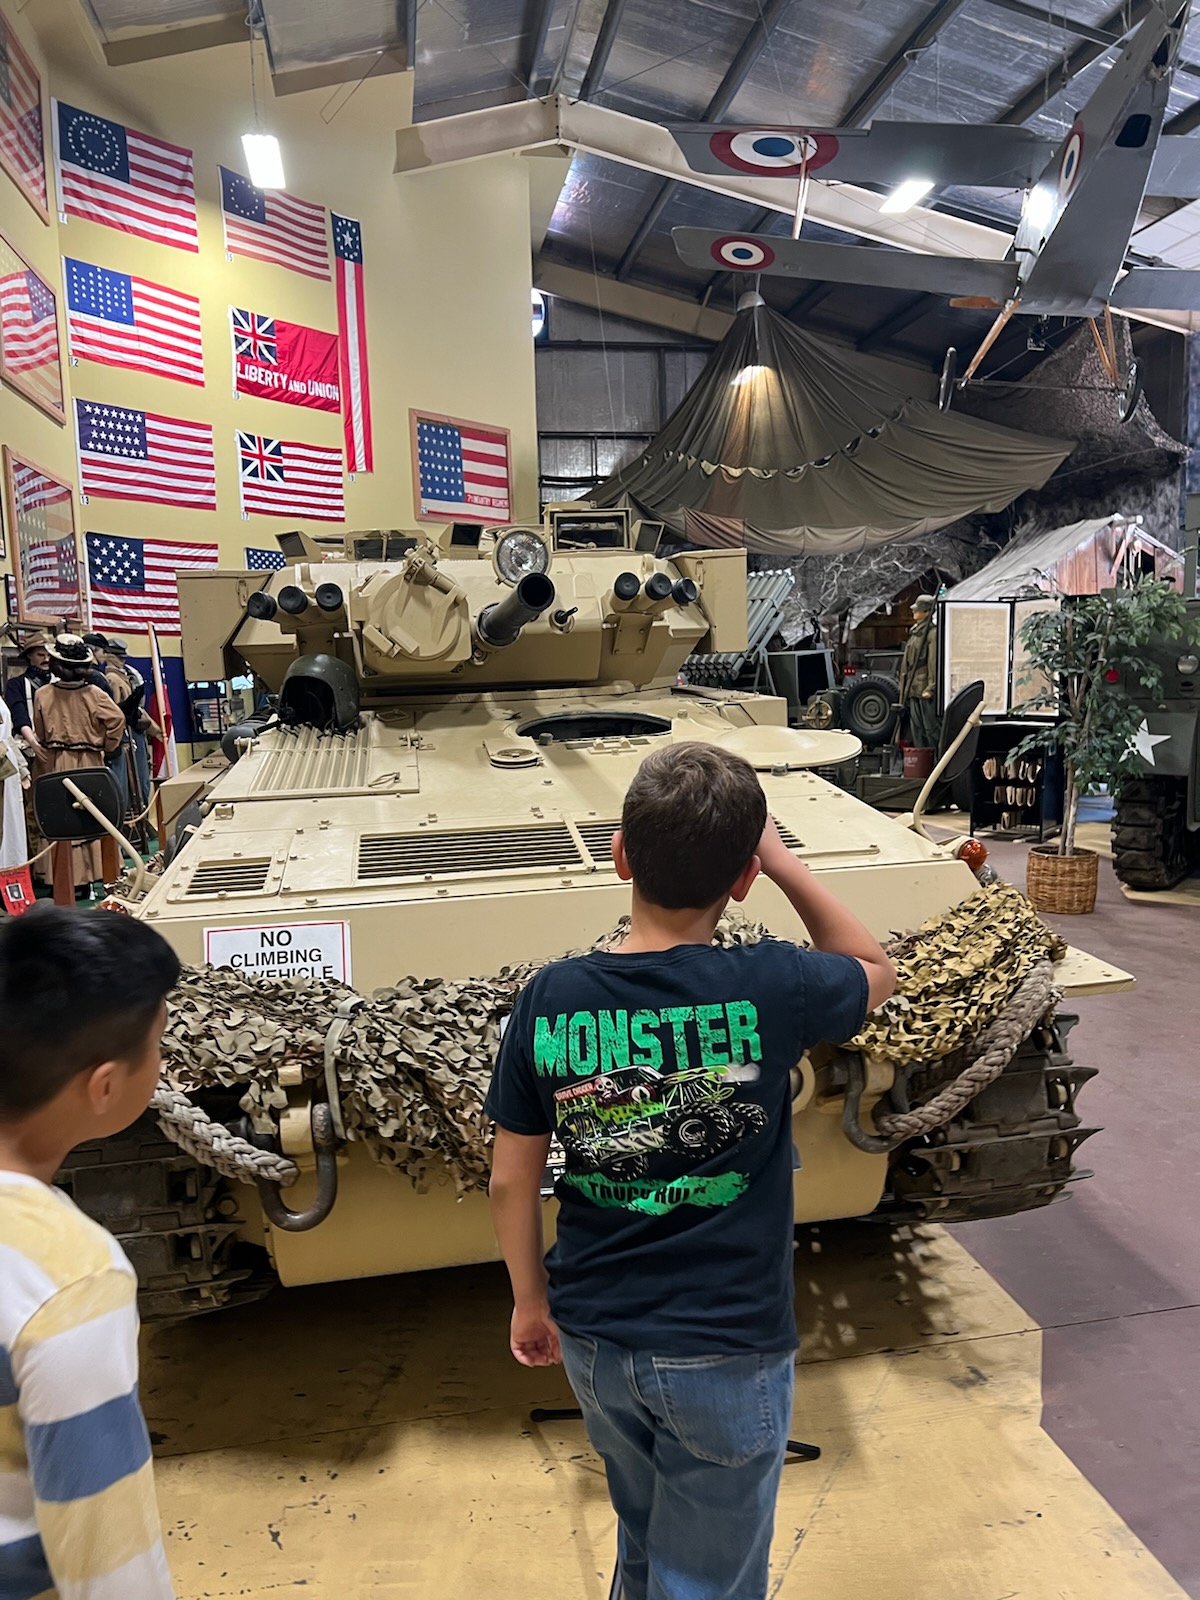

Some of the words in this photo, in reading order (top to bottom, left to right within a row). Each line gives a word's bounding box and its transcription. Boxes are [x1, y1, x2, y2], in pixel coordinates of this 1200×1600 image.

[70, 356, 79, 367] 12
[237, 362, 288, 389] LIBERTY
[288, 380, 306, 395] AND
[308, 380, 339, 401] UNION
[81, 495, 90, 505] 13
[260, 930, 292, 947] NO
[230, 948, 322, 968] CLIMBING
[533, 1000, 762, 1078] MONSTER
